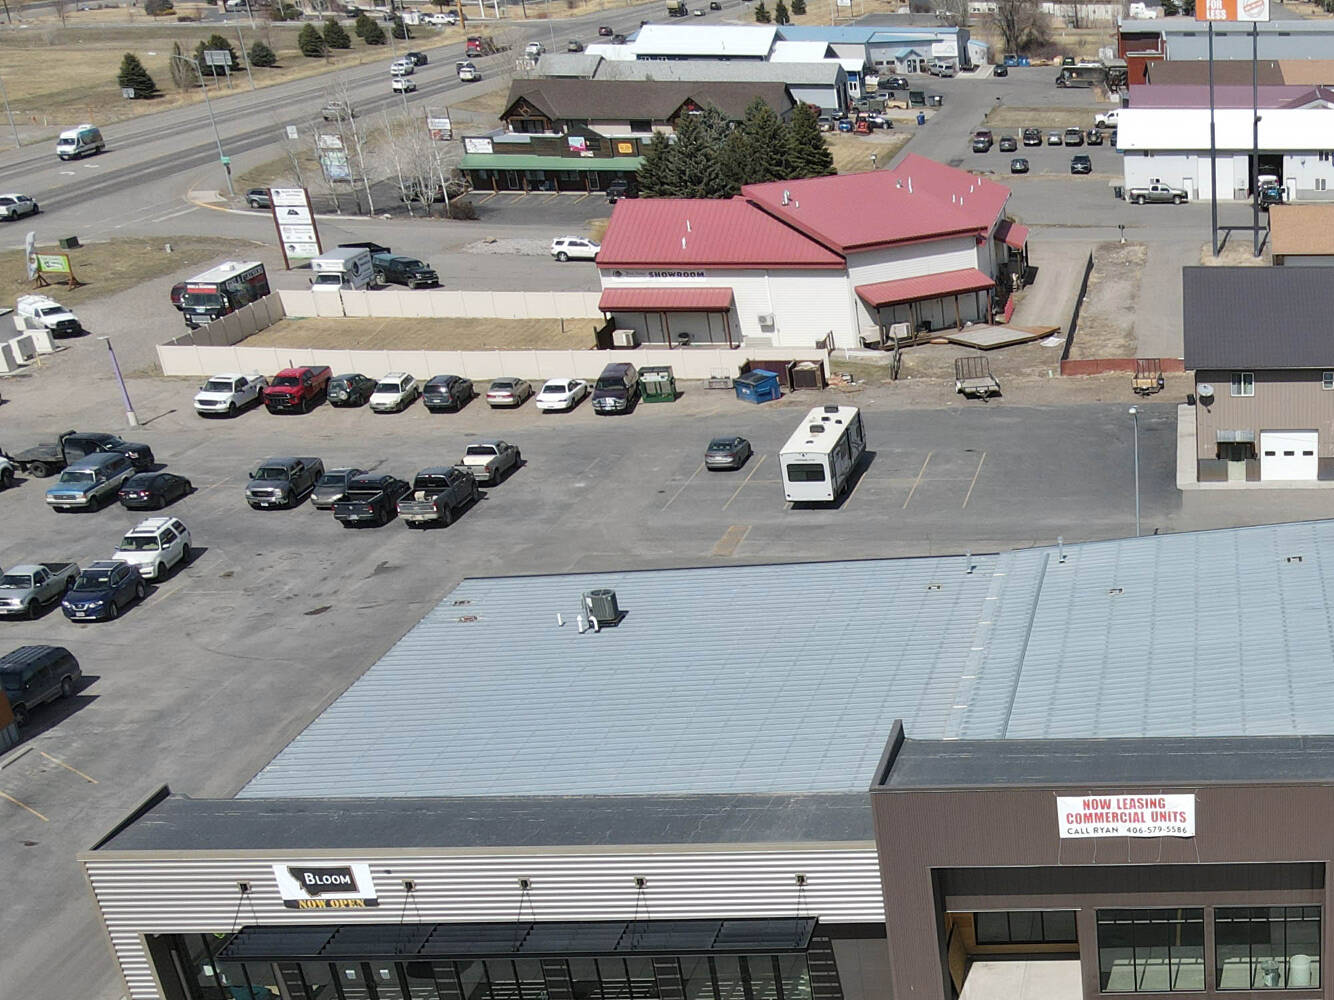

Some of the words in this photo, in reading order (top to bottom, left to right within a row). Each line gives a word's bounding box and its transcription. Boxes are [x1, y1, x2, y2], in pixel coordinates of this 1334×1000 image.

[1207, 9, 1227, 20] LESS
[1082, 798, 1111, 811] NOW
[1116, 797, 1166, 810] LEASING
[1066, 811, 1146, 825] COMMERCIAL
[1150, 811, 1187, 823] UNITS
[1066, 827, 1090, 835] CALL
[1093, 826, 1119, 834] RYAN
[298, 899, 326, 909] NOW
[330, 898, 365, 908] OPEN
